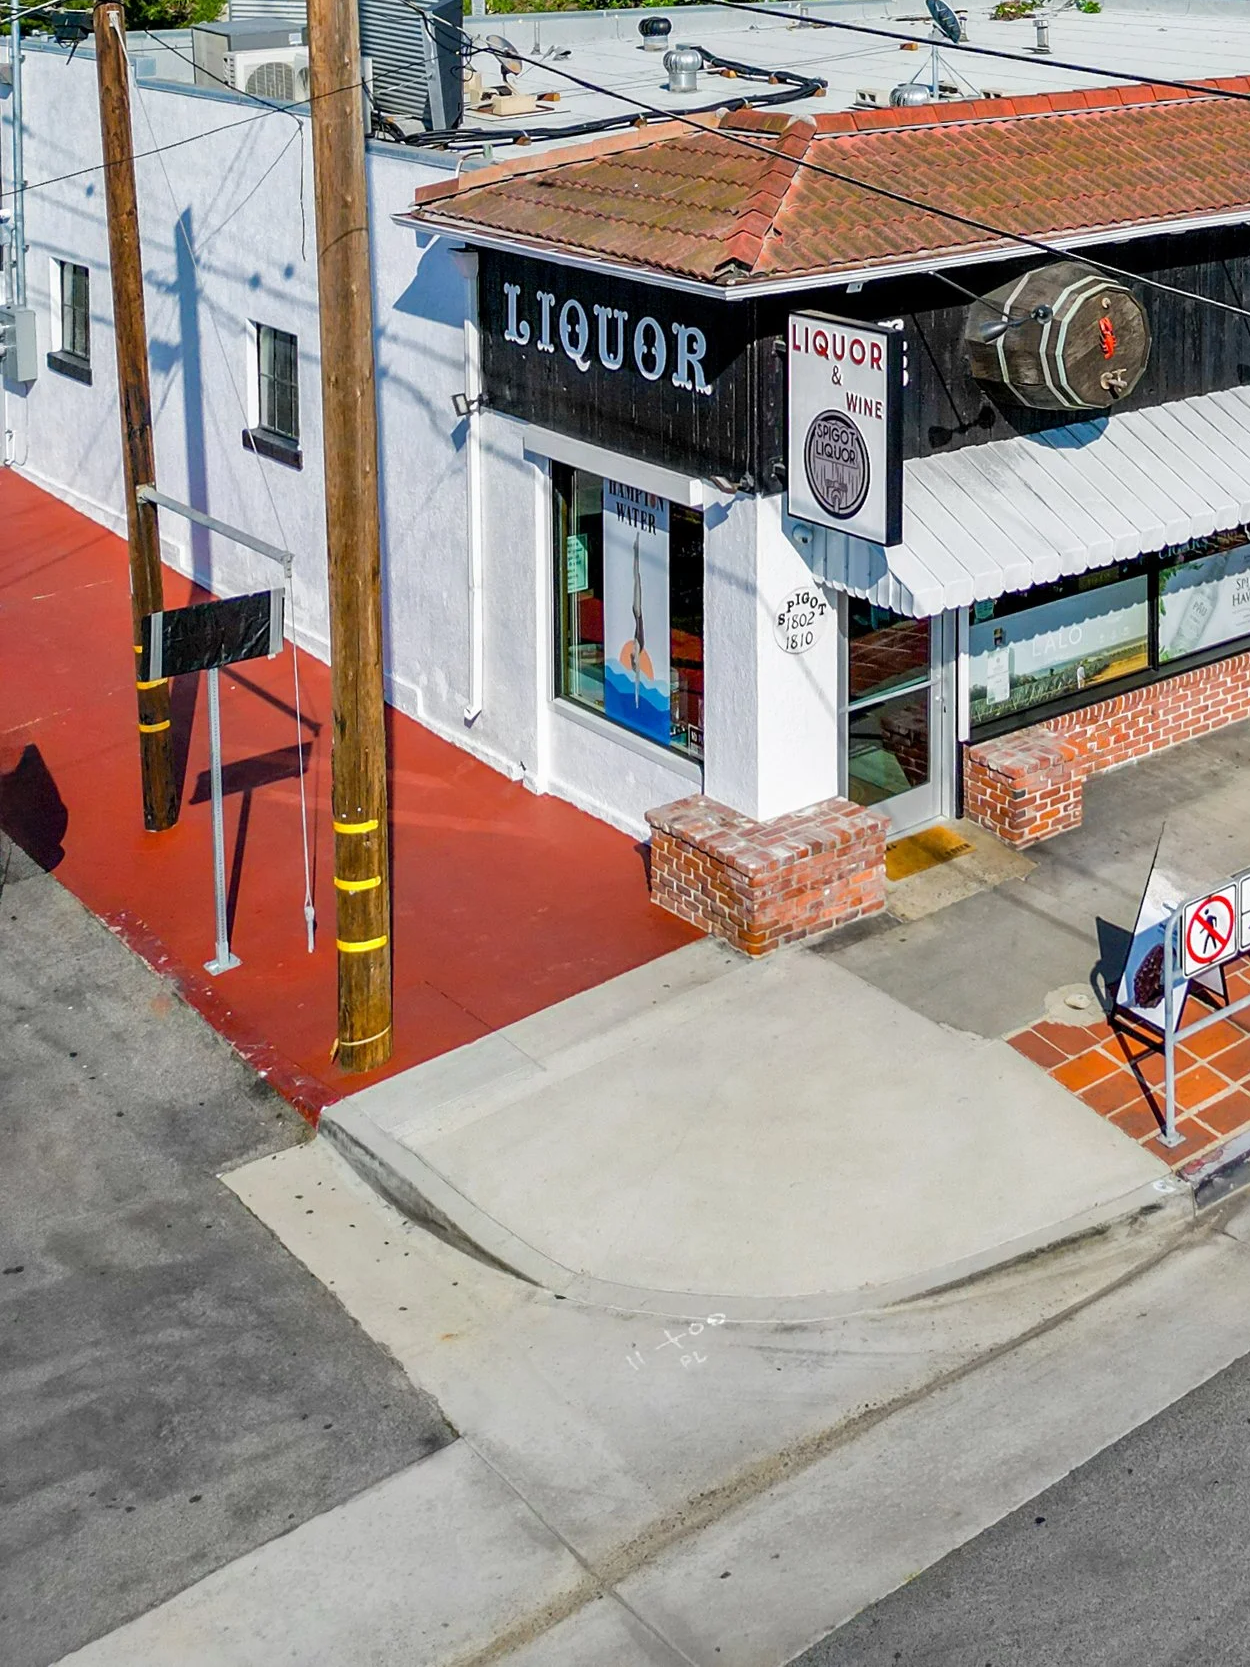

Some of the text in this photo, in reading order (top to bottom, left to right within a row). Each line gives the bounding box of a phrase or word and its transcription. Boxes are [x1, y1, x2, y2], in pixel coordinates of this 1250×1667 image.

[503, 282, 712, 396] LIQUOR
[792, 323, 883, 371] LIQUOR
[831, 365, 842, 386] &
[846, 391, 883, 420] WINE
[816, 423, 856, 447] SPIGOT
[815, 440, 856, 465] LIQUOR
[616, 502, 657, 536] WATER
[777, 592, 827, 626] SPIGOT
[786, 611, 816, 632] 1802
[785, 631, 814, 651] 1810
[1032, 626, 1083, 658] LALO
